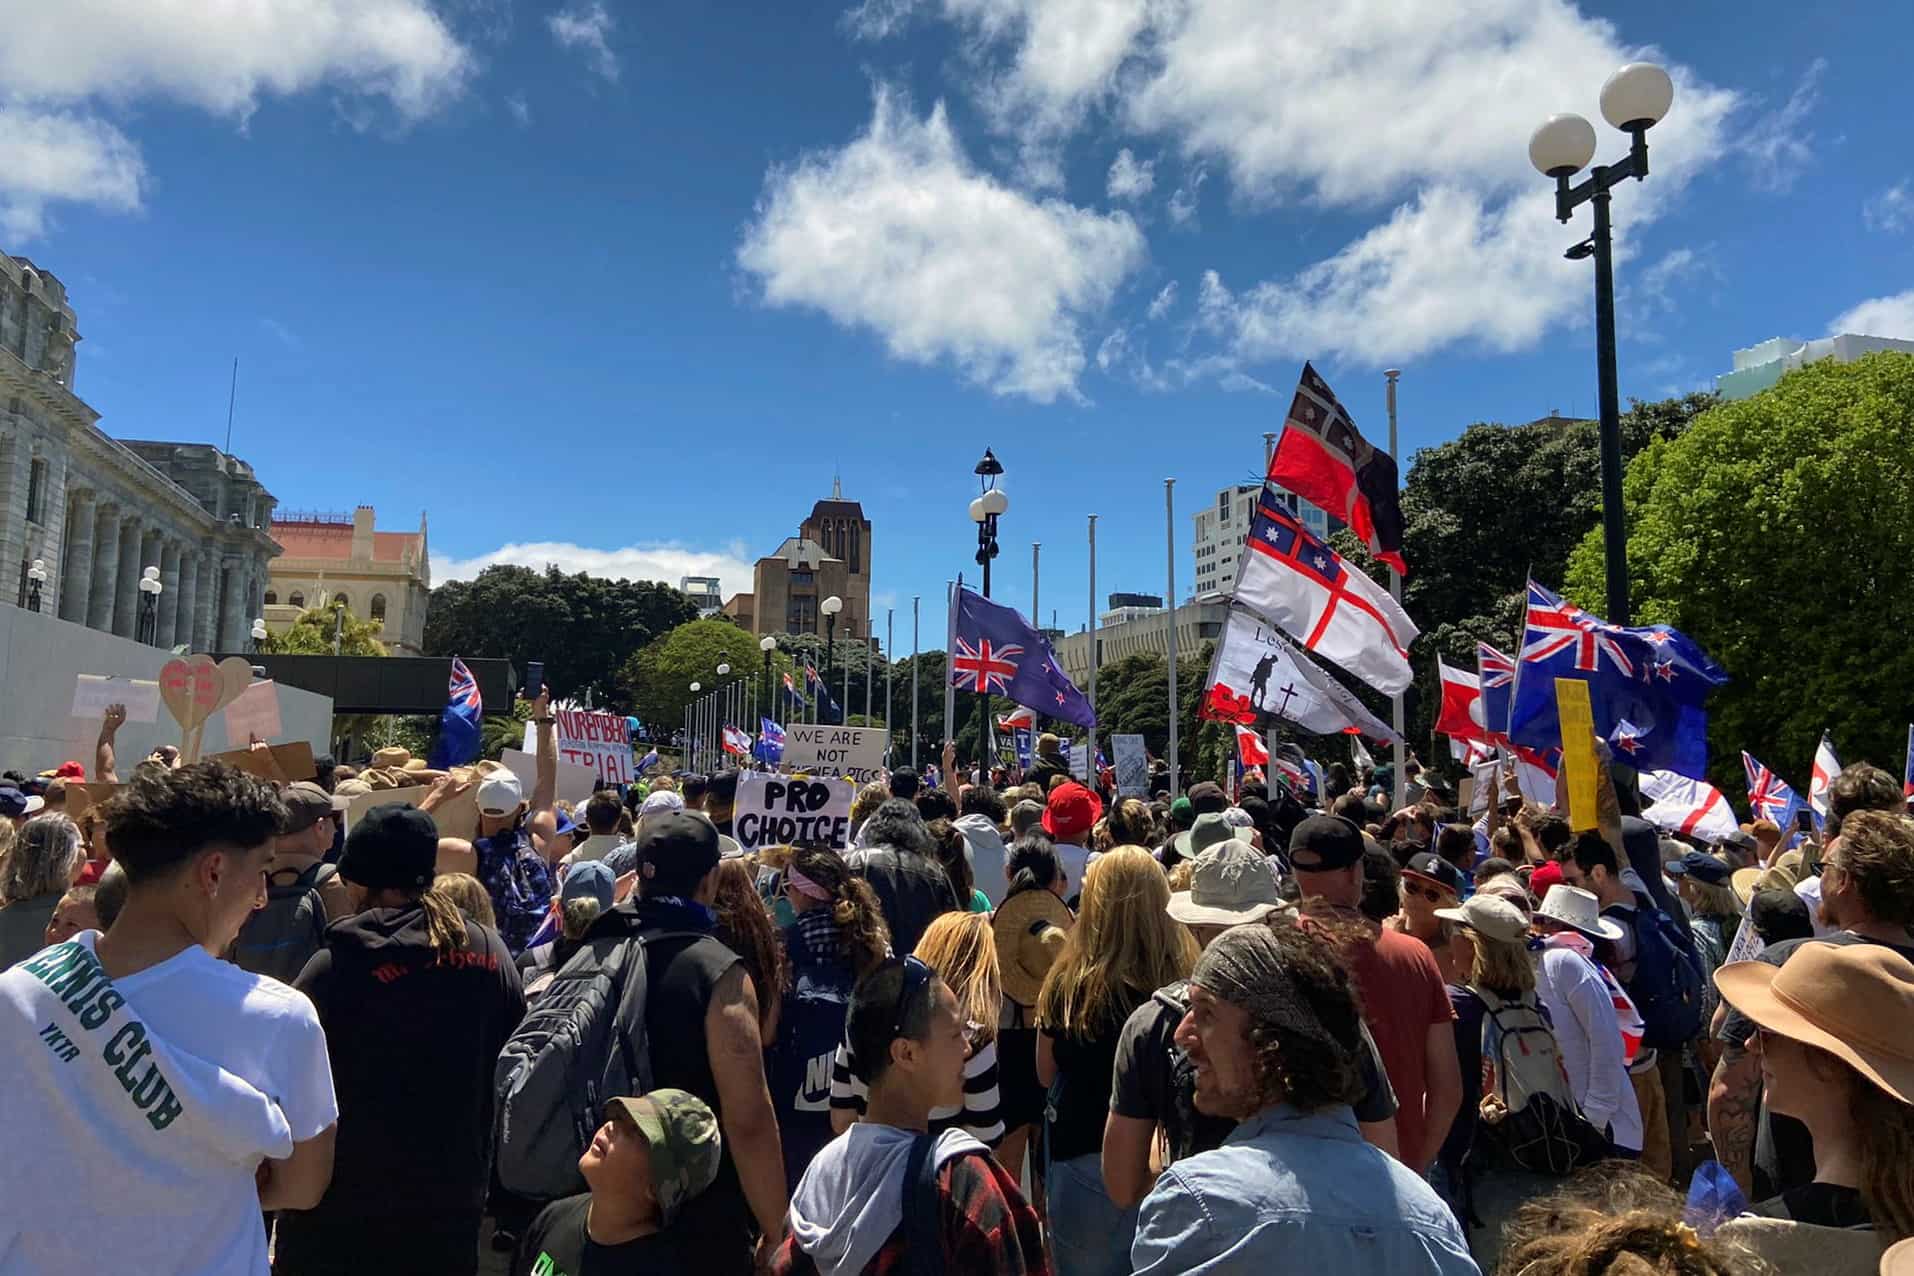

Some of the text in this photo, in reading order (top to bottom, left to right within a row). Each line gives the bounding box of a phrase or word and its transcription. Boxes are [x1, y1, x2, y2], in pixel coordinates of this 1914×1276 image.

[794, 730, 862, 746] WE ARE
[561, 749, 634, 785] TRIAL
[817, 749, 849, 762] NOT
[847, 767, 880, 784] PIGS
[764, 780, 830, 813] PRO
[737, 813, 849, 849] CHOICE
[39, 1022, 81, 1063] YKTR
[103, 1021, 183, 1130] CLUB
